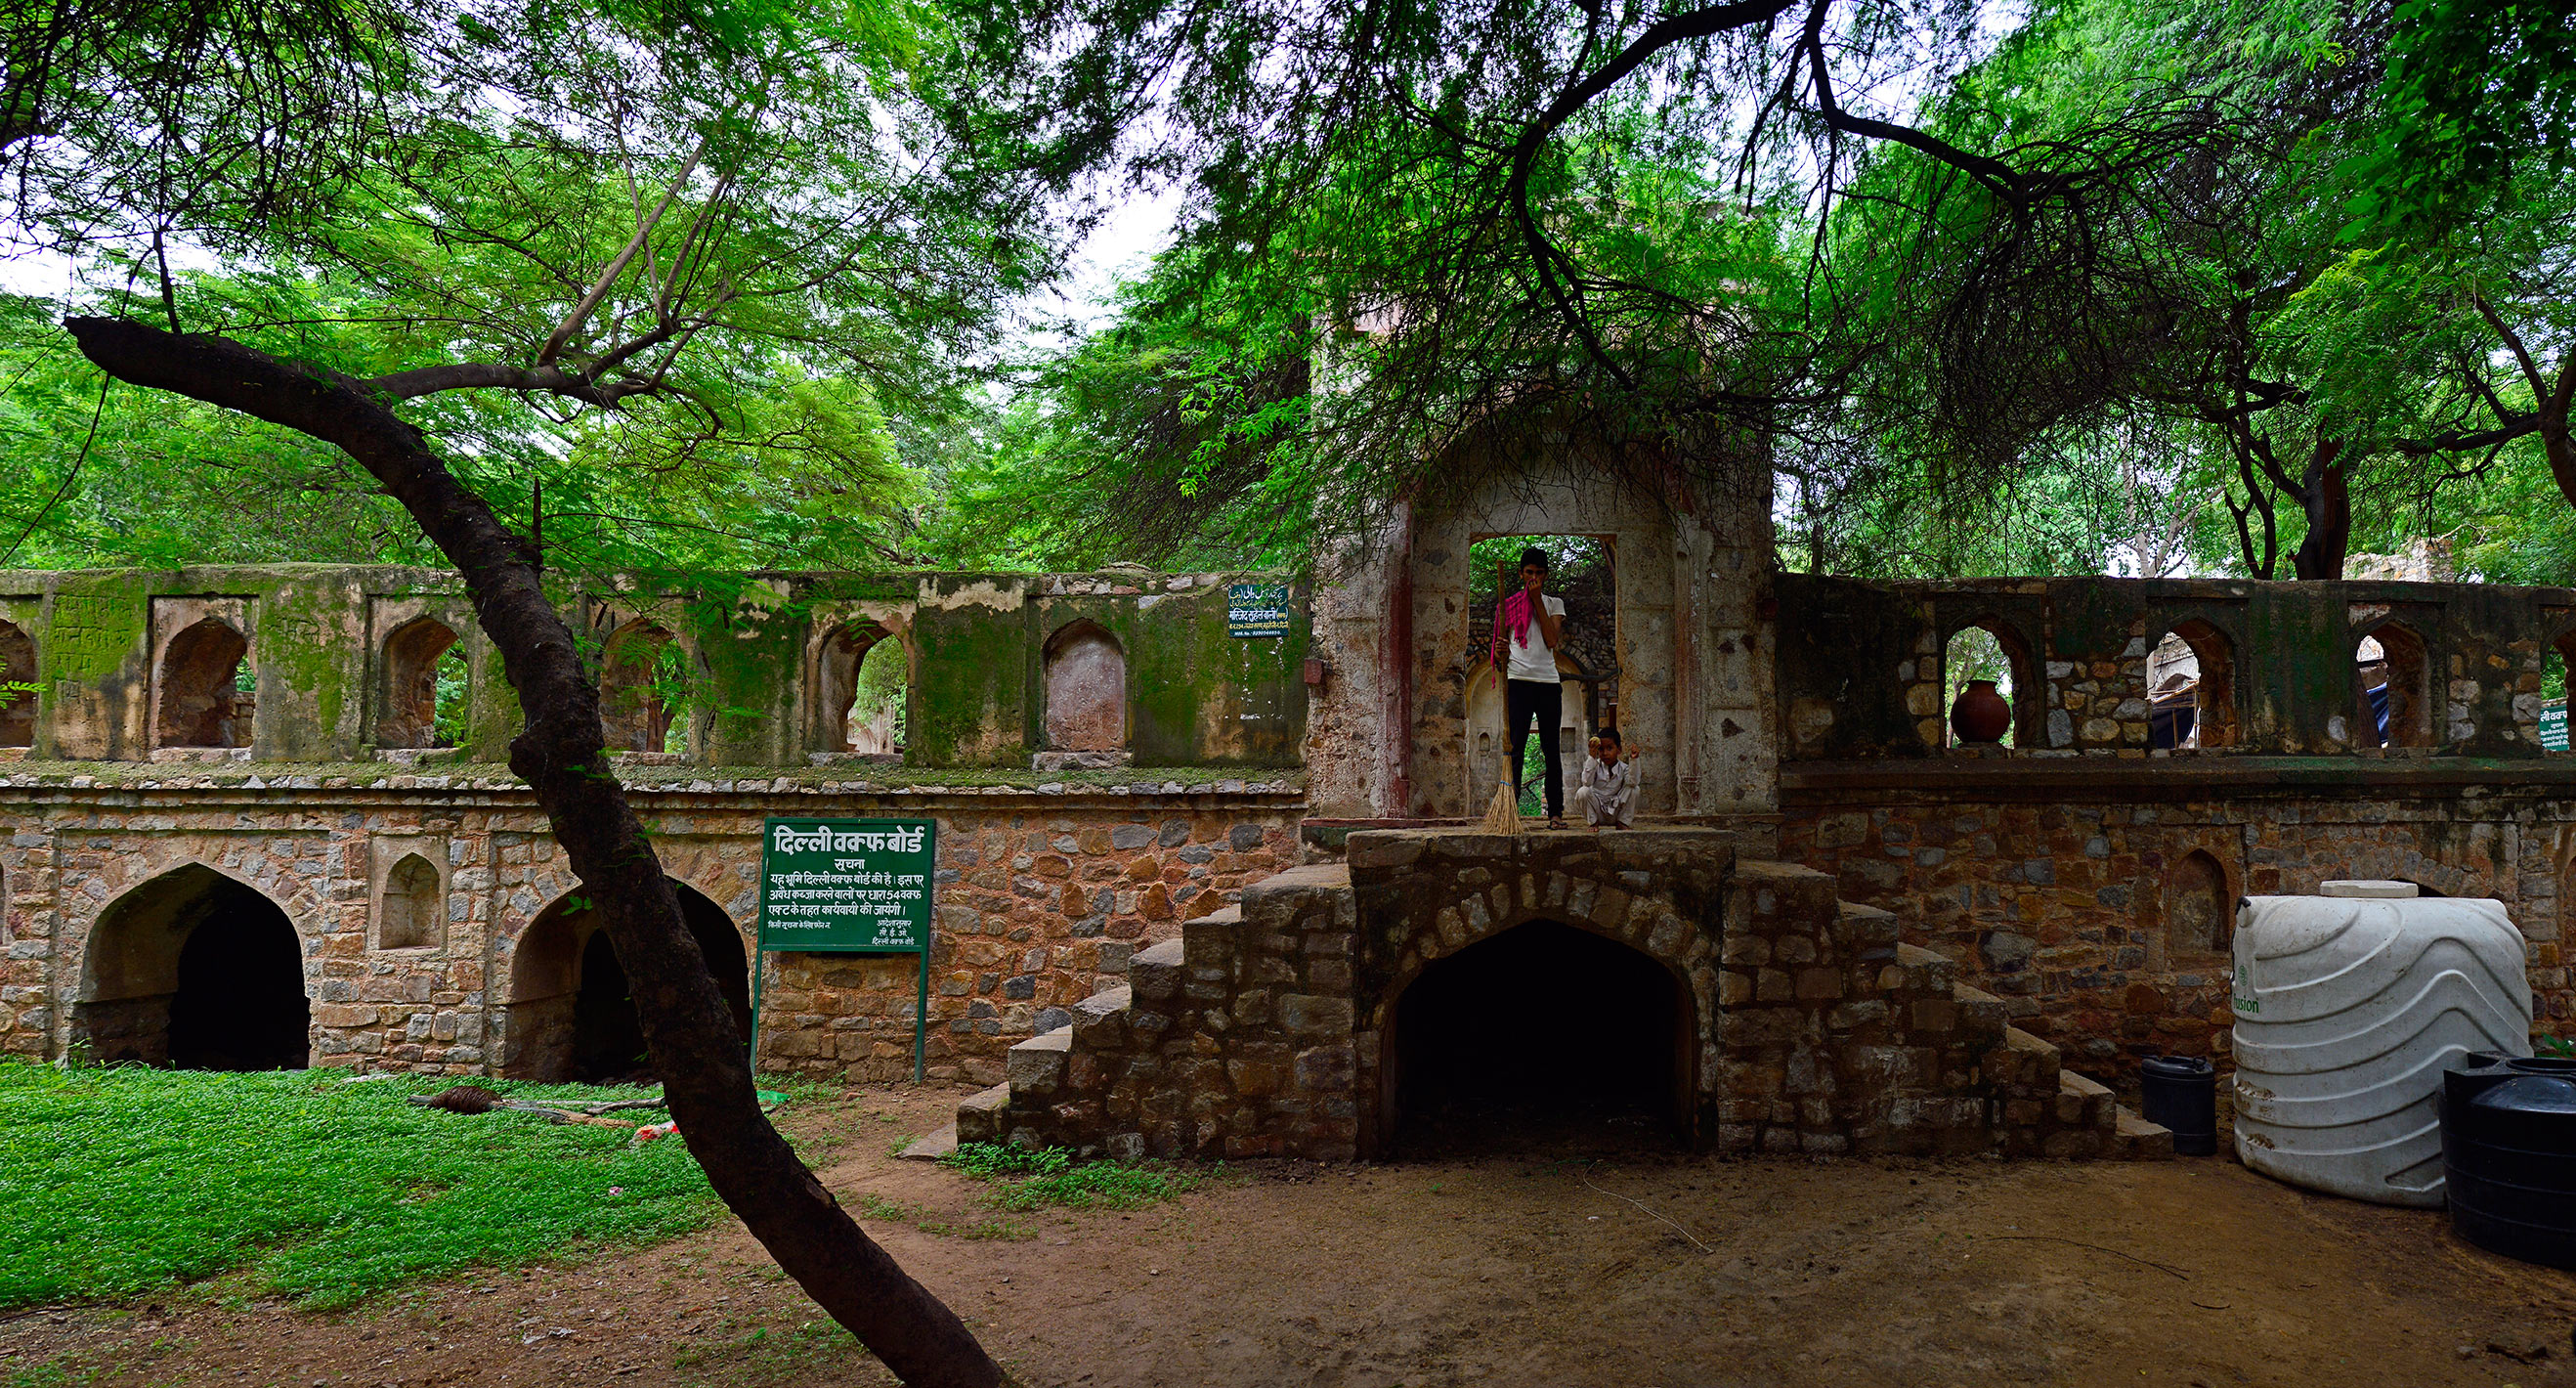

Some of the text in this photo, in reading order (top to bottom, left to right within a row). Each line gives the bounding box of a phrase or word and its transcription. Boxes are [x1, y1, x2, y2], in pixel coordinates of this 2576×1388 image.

[774, 825, 834, 855] दिल्ली
[886, 825, 925, 852] बोर्ड
[835, 858, 865, 872] सूचना
[770, 874, 785, 887] यह
[785, 871, 803, 888] भूमि
[803, 871, 831, 887] दिल्ली
[854, 872, 871, 886] बोर्ड
[872, 872, 882, 885] की
[897, 874, 913, 888] इस
[913, 874, 923, 888] पर
[769, 887, 792, 900] अवैध
[815, 887, 834, 900] करने
[835, 887, 855, 900] वालों
[856, 889, 867, 902] पर
[869, 889, 886, 900] धारा
[886, 889, 900, 900] 54
[768, 905, 791, 916] एक्ट
[791, 901, 799, 916] के
[799, 905, 820, 918] तहत
[860, 902, 873, 916] की
[877, 918, 912, 929] आदेशानुसार
[872, 936, 889, 946] दिल्ली
